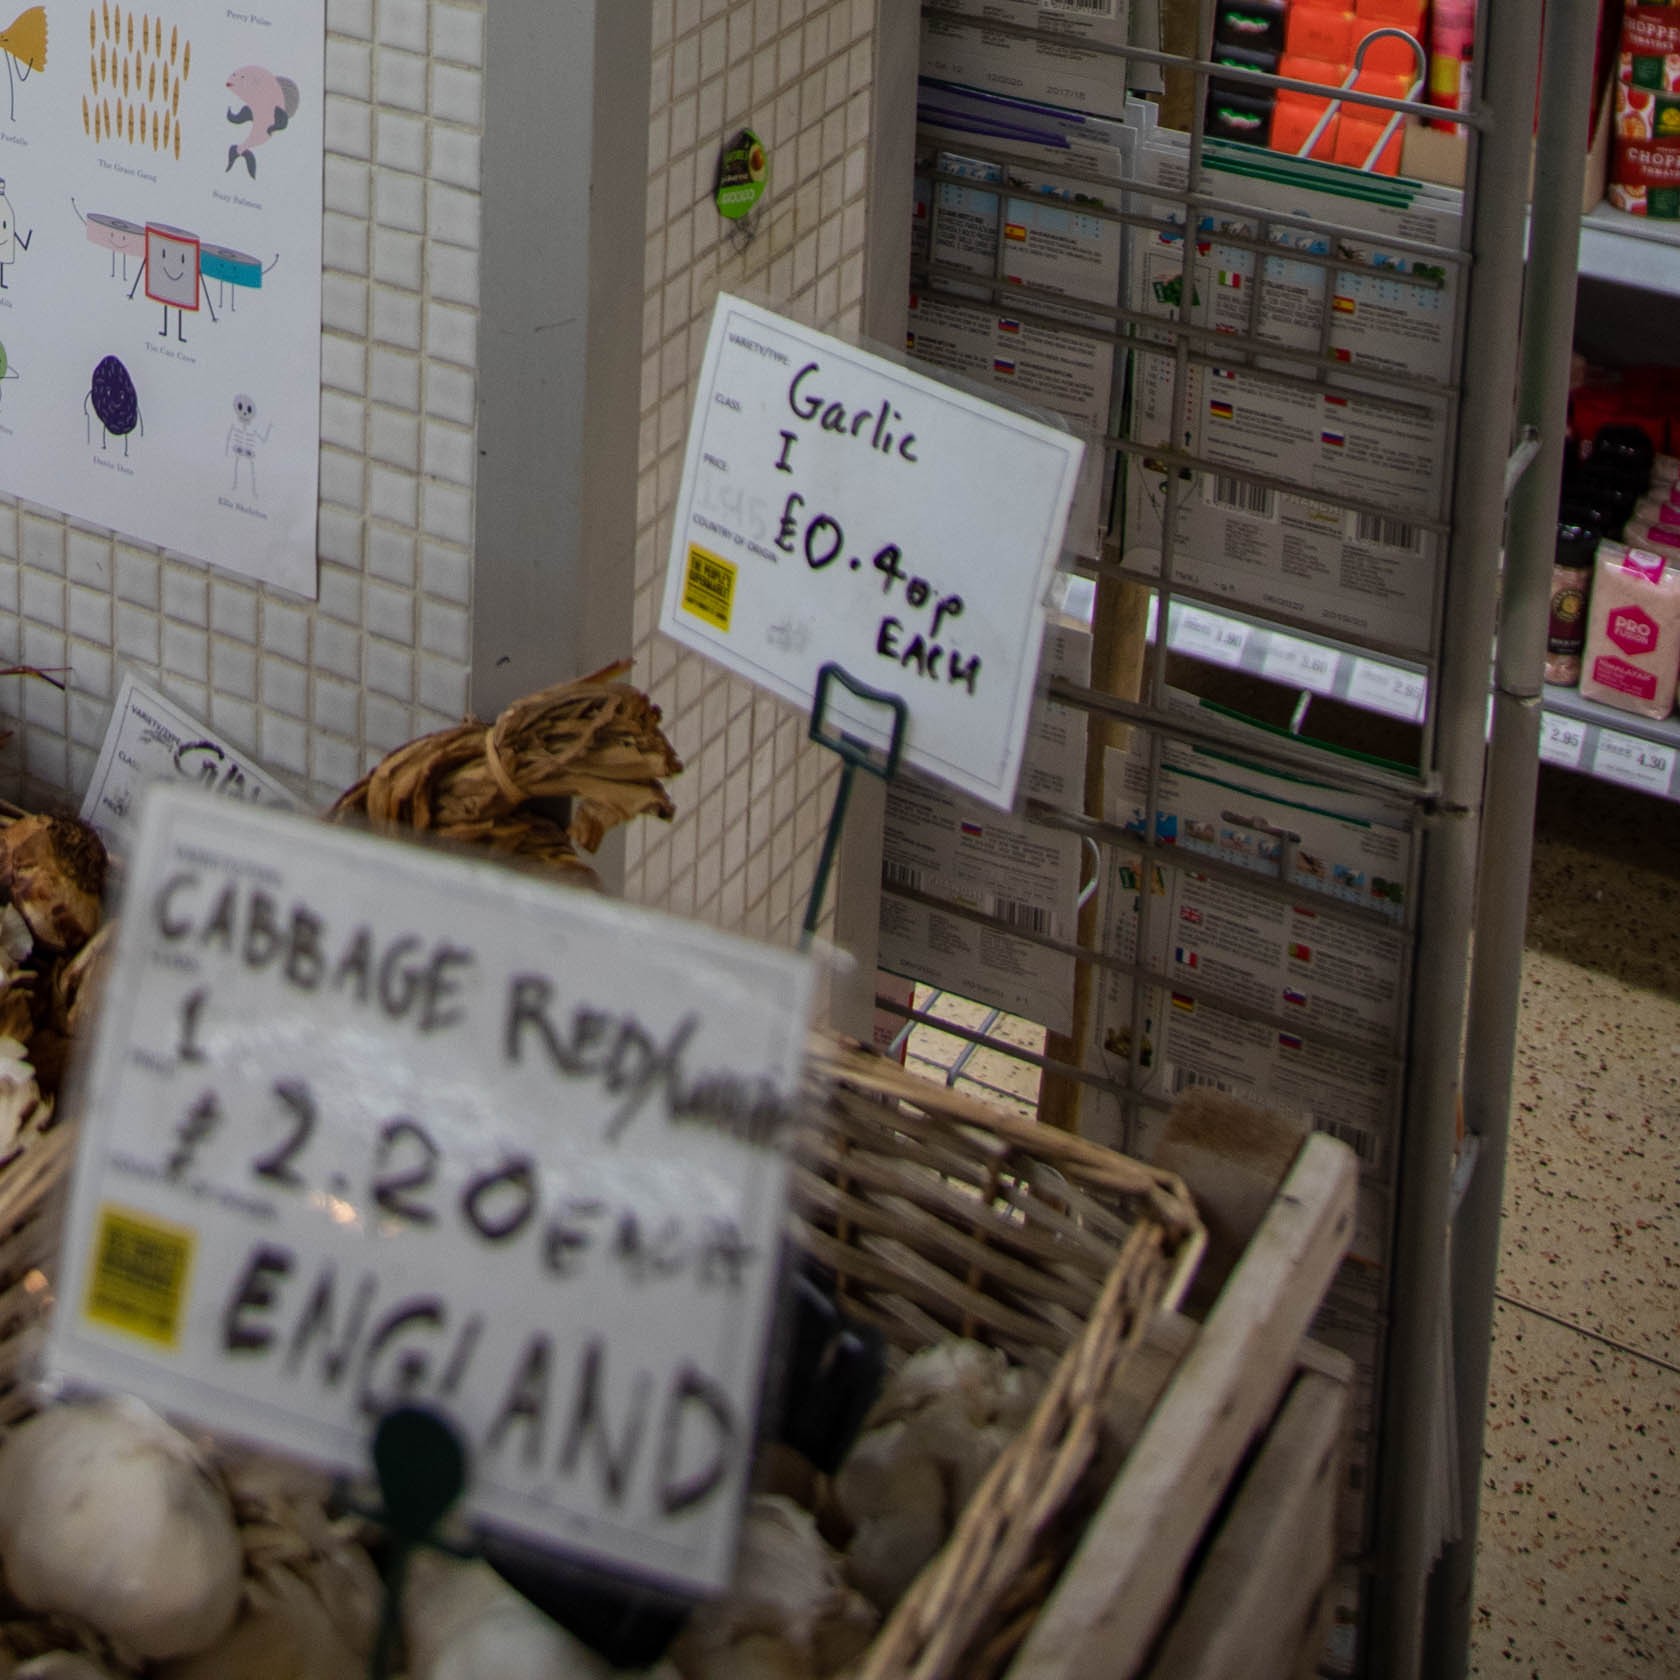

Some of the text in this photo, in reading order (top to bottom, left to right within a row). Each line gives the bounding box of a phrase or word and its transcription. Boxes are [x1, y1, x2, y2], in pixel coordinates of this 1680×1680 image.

[1627, 146, 1680, 169] CHOP
[788, 362, 919, 463] Garlic
[693, 512, 733, 541] COUNTRY
[733, 533, 744, 546] OF
[876, 616, 982, 697] EACH
[1615, 615, 1652, 637] PRO
[154, 872, 474, 1030] CABBAGE
[221, 1242, 744, 1516] ENGLAND
